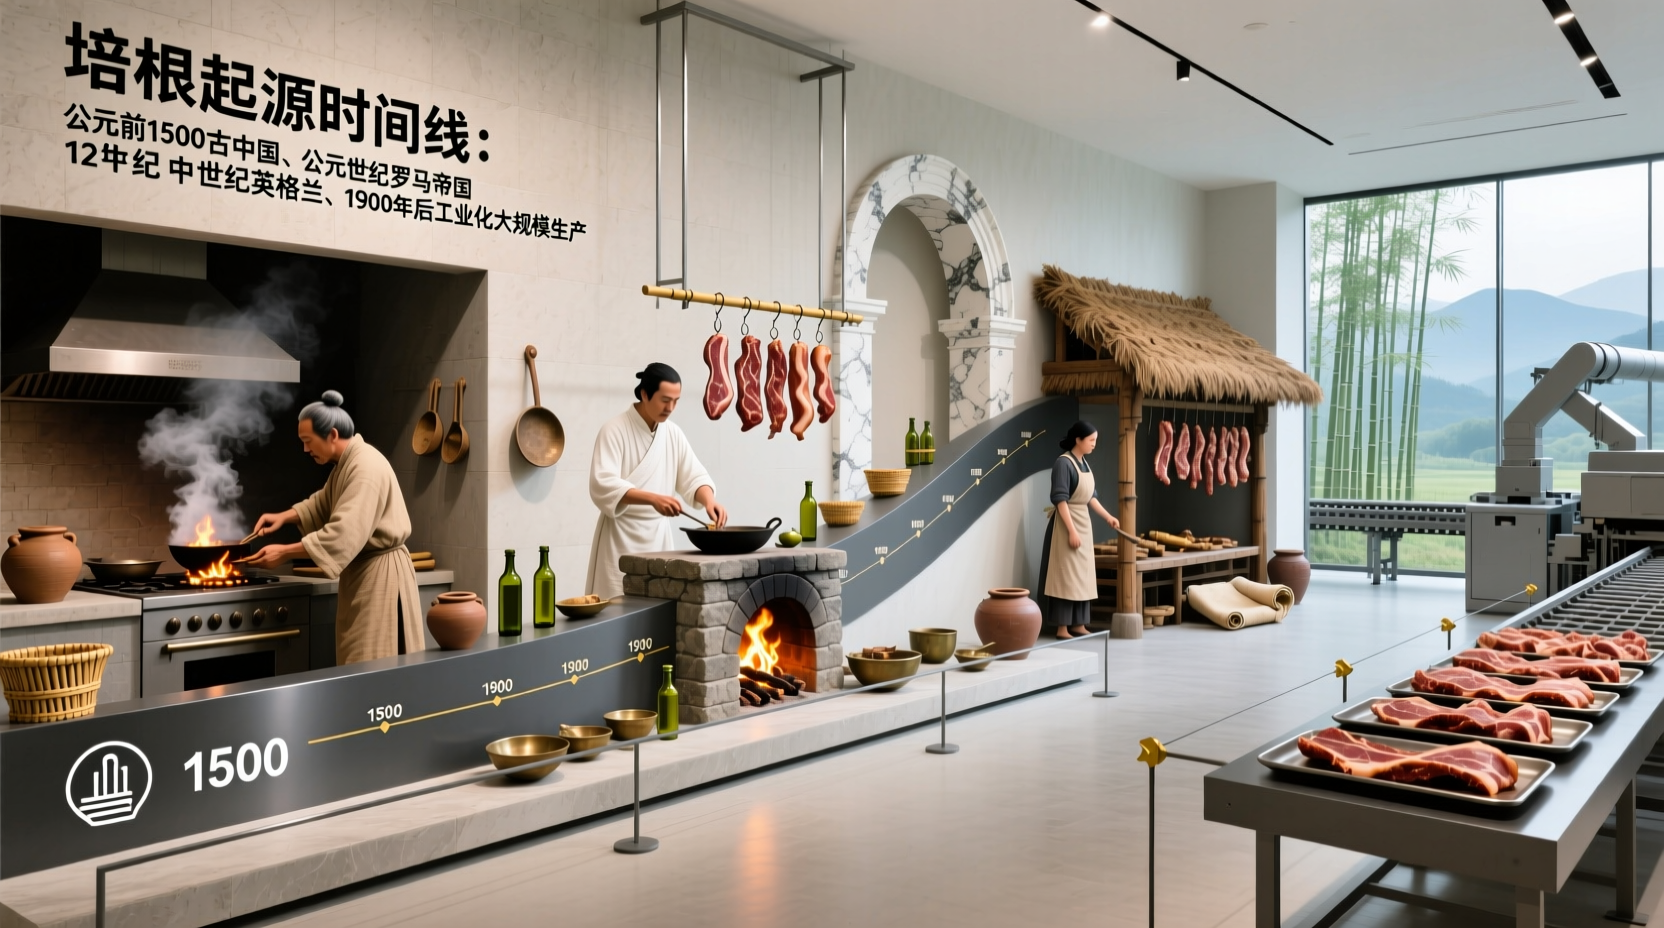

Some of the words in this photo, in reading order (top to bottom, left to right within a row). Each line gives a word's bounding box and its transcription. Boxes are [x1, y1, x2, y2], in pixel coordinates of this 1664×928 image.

[63, 20, 489, 164] 培根起源时间线：
[63, 102, 472, 200] 公元前1500古中国、公元世纪罗马帝国
[169, 155, 587, 243] 中世纪英格兰、1900年后工业化大规模生产
[628, 637, 653, 652] 1900
[561, 658, 589, 675] 1900
[481, 678, 513, 696] 1900
[366, 703, 403, 722] 1500
[183, 737, 289, 793] 1500
